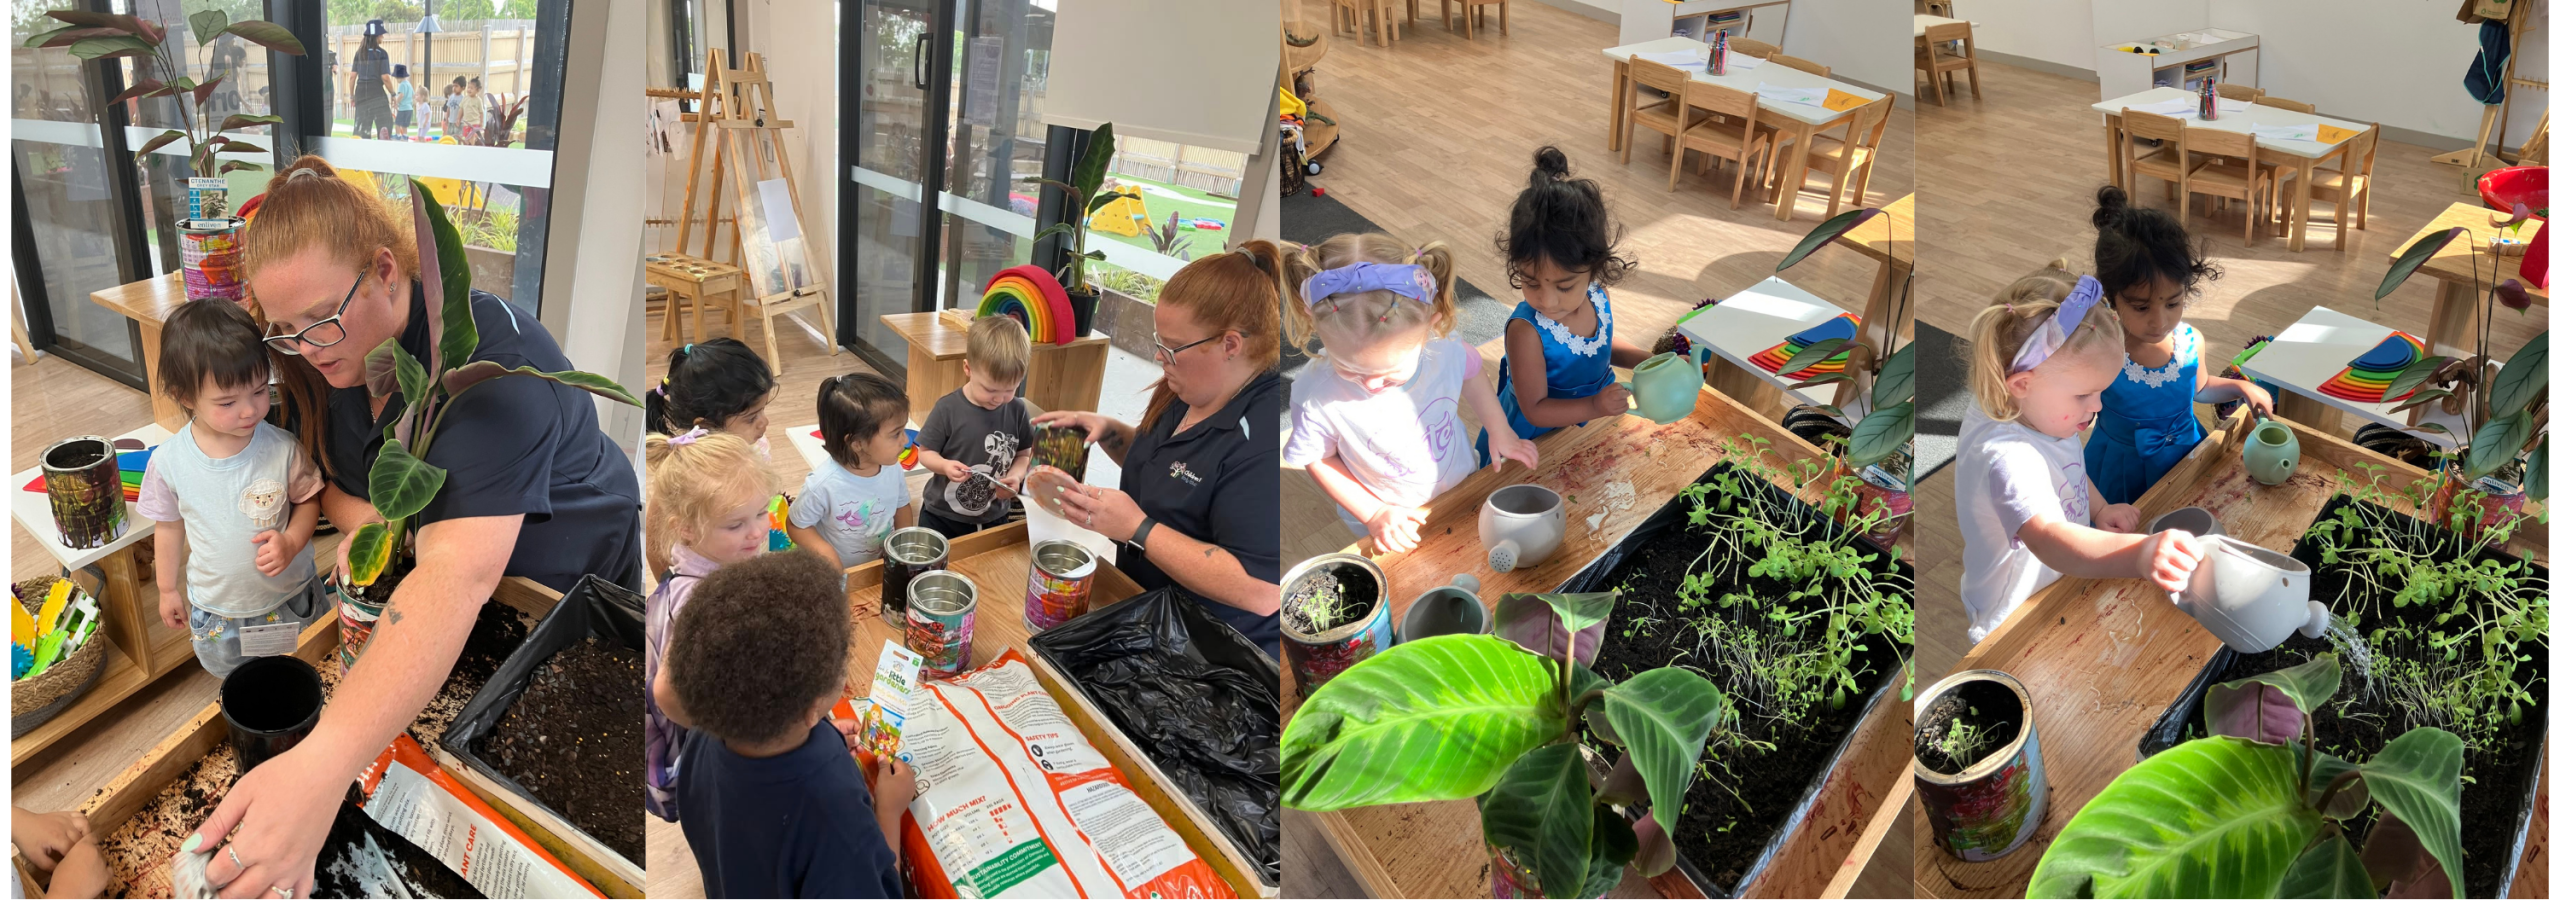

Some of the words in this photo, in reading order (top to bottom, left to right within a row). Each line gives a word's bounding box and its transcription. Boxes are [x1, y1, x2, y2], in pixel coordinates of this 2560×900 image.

[1873, 469, 1897, 486] enliven
[2483, 478, 2509, 490] enliven
[876, 673, 910, 694] gardeners
[889, 672, 906, 685] little
[398, 808, 407, 825] potting
[927, 816, 945, 832] HOW
[946, 804, 969, 818] MUCH
[969, 796, 985, 806] MIX?
[460, 852, 471, 880] ANT
[466, 823, 477, 852] CARE
[971, 858, 1008, 880] SUSTAINABILITY
[1010, 842, 1041, 860] COMMITMENT
[1007, 858, 1025, 870] production
[492, 870, 500, 897] immediately
